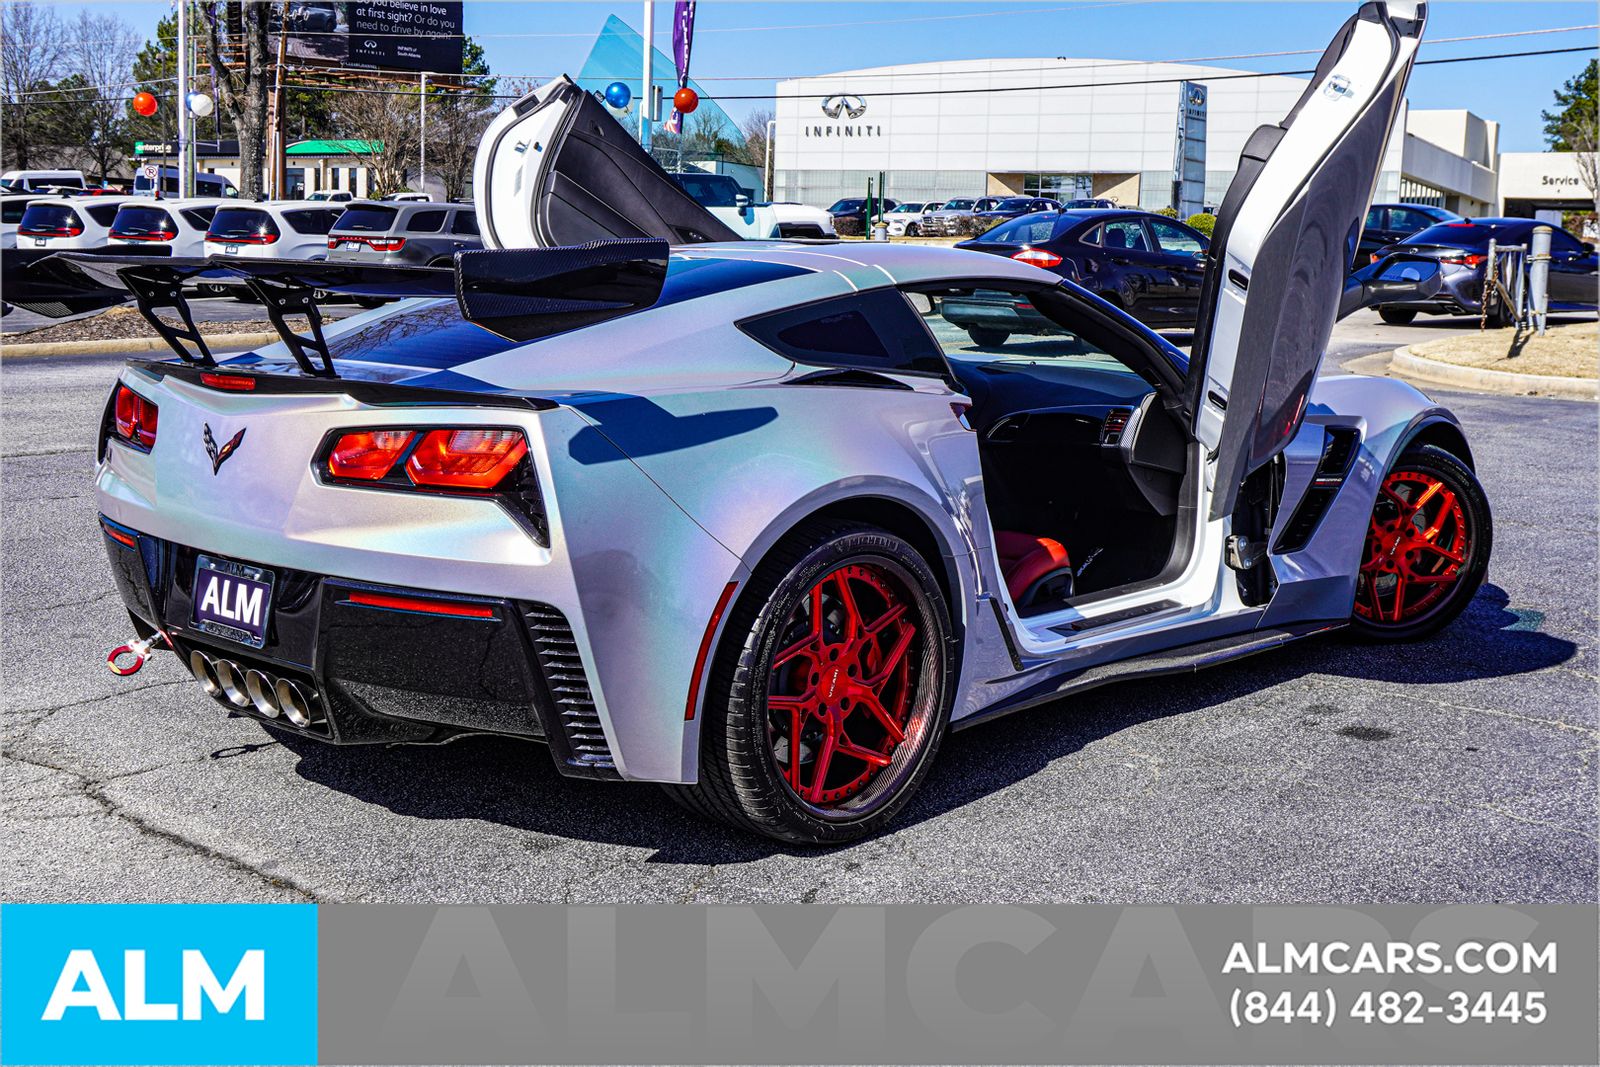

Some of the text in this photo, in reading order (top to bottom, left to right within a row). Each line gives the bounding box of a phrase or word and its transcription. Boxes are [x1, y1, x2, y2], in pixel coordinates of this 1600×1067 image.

[390, 0, 418, 11] believe
[420, 3, 428, 13] in
[430, 4, 447, 15] love
[356, 7, 455, 29] at first sight? Or do you
[356, 21, 453, 40] need to drive by again?
[805, 125, 881, 137] INFINITI
[1542, 175, 1579, 185] Service
[200, 576, 264, 627] ALM
